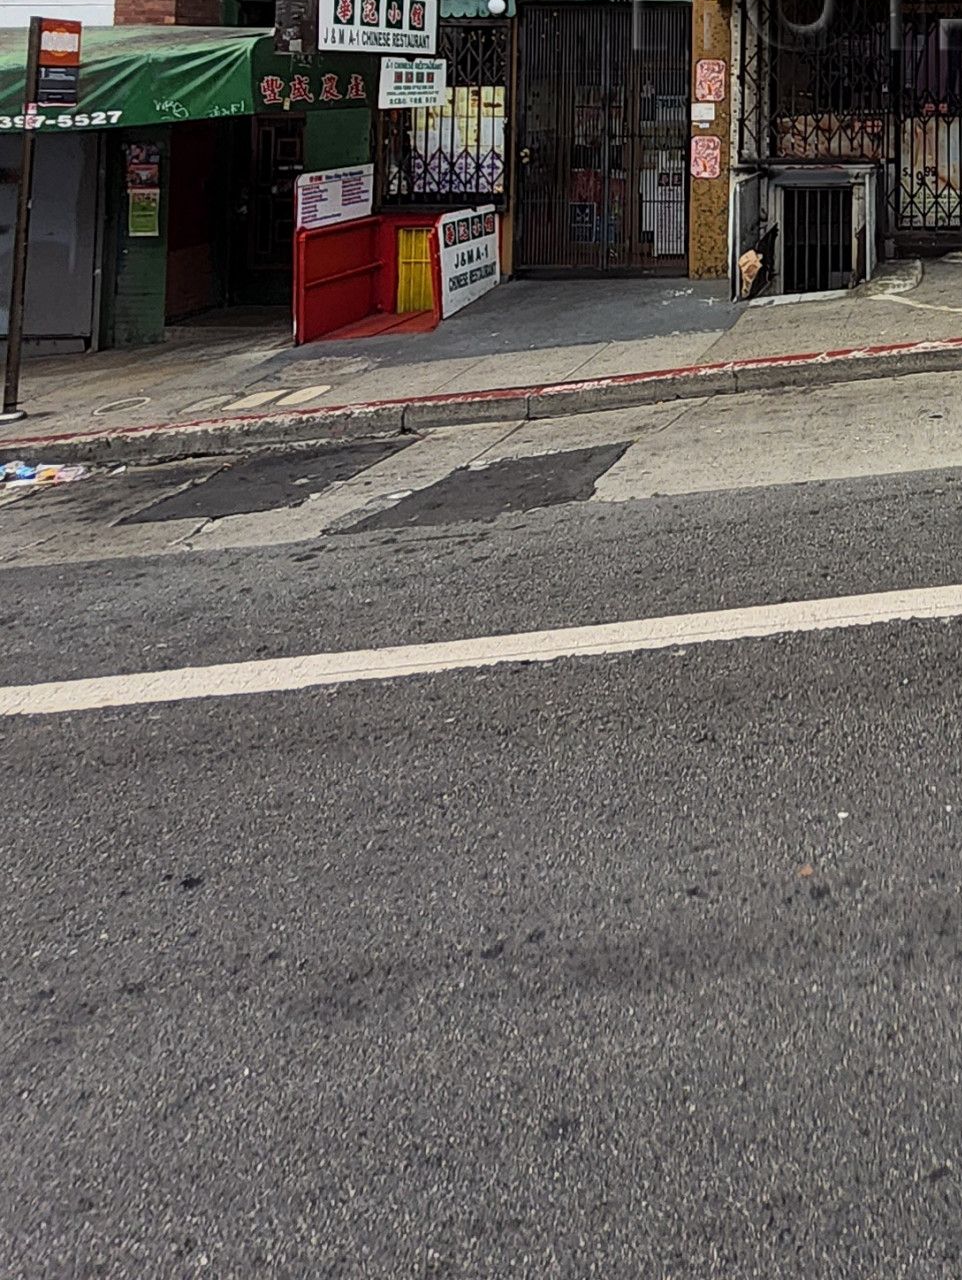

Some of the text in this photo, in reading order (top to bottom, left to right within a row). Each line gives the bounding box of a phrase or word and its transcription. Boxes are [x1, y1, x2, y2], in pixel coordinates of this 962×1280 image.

[323, 27, 330, 44] J
[338, 28, 345, 45] M
[361, 30, 392, 48] CHINESE
[392, 31, 431, 49] RESTAURANT
